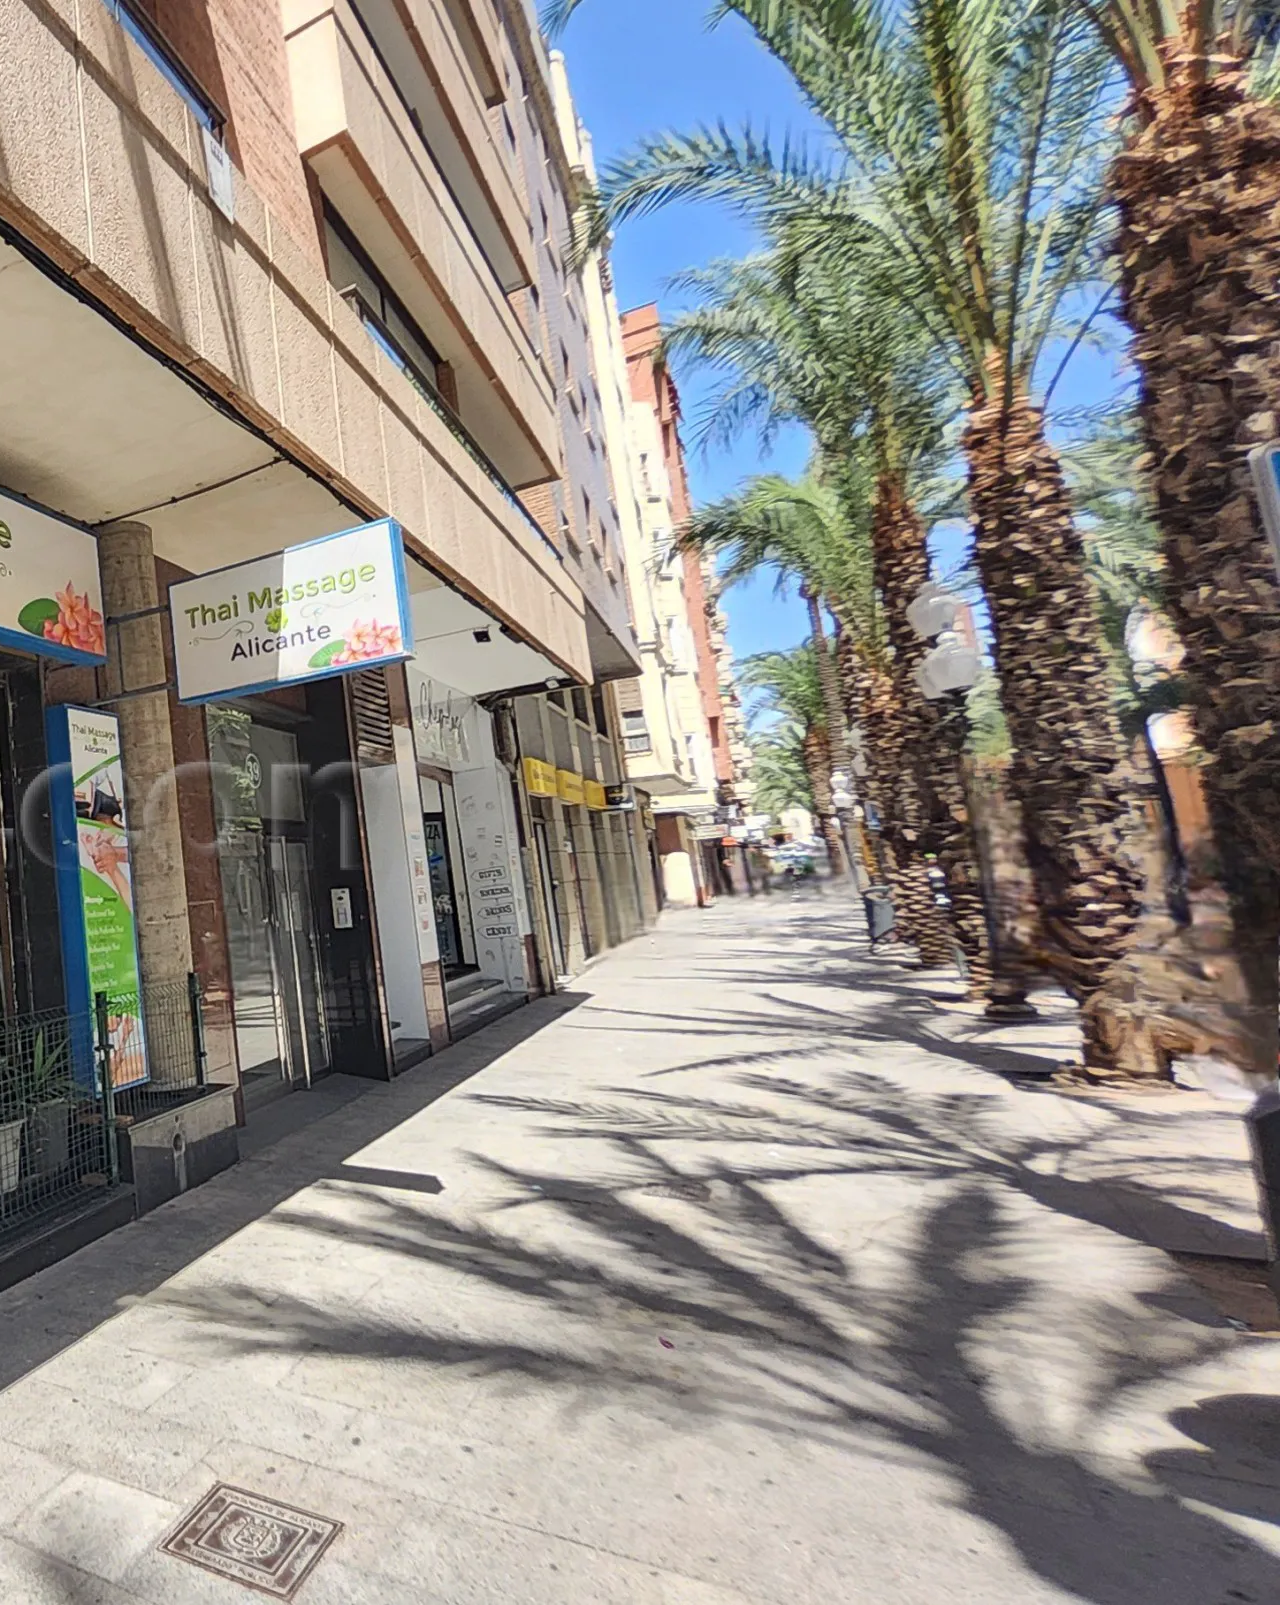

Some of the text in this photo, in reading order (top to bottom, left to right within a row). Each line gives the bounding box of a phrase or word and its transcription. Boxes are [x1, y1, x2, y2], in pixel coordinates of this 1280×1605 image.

[184, 562, 377, 629] Thai Massage
[230, 622, 332, 662] Alicante
[72, 723, 117, 742] Thai Massage
[84, 744, 108, 755] Alicante
[247, 761, 259, 781] 39
